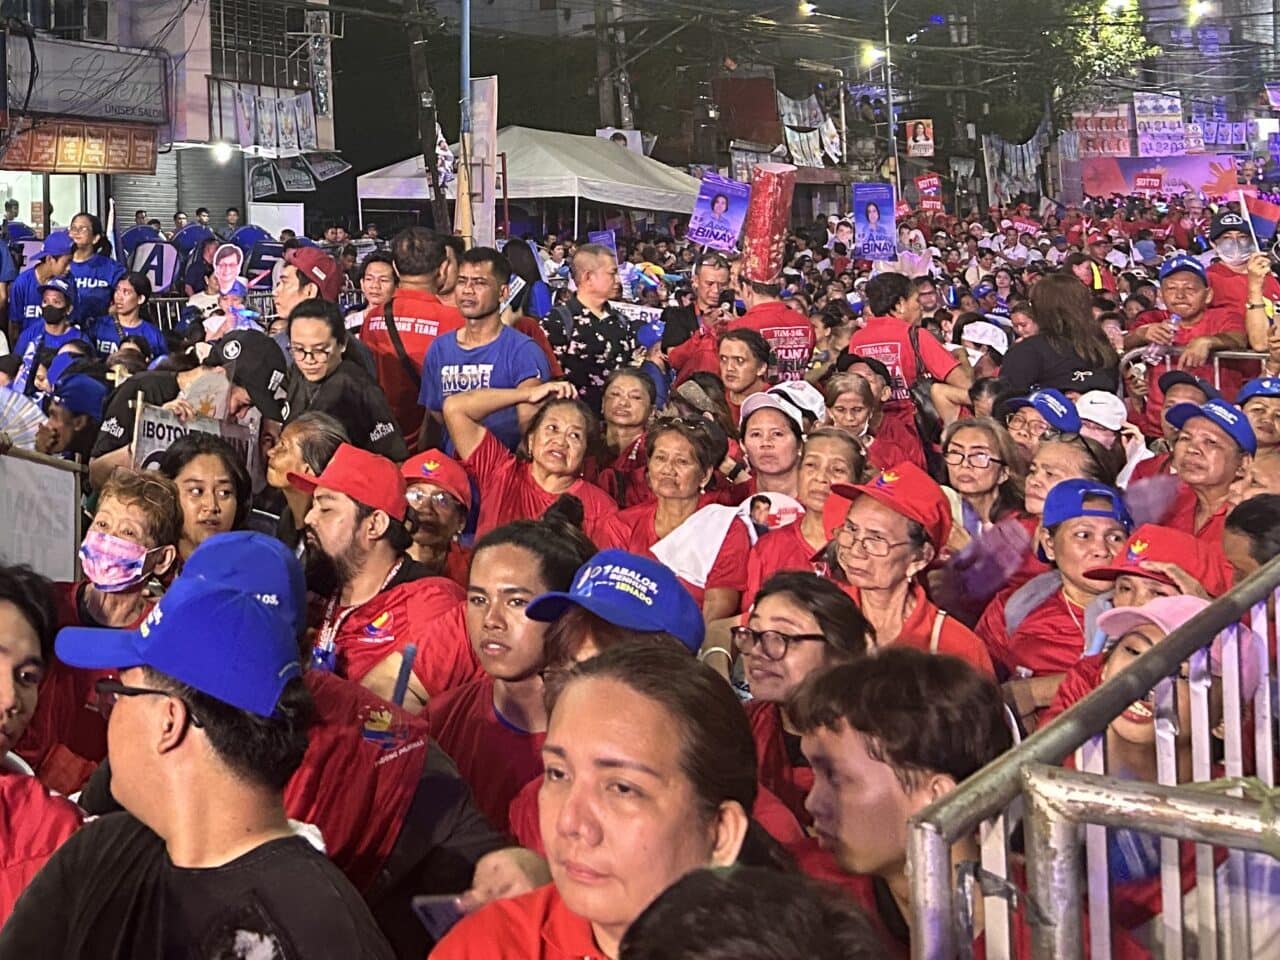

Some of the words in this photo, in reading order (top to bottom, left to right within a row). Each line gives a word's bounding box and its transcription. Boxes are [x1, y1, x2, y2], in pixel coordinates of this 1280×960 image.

[695, 227, 735, 243] BINAY
[862, 242, 894, 254] BINAY
[414, 323, 438, 337] TEAM
